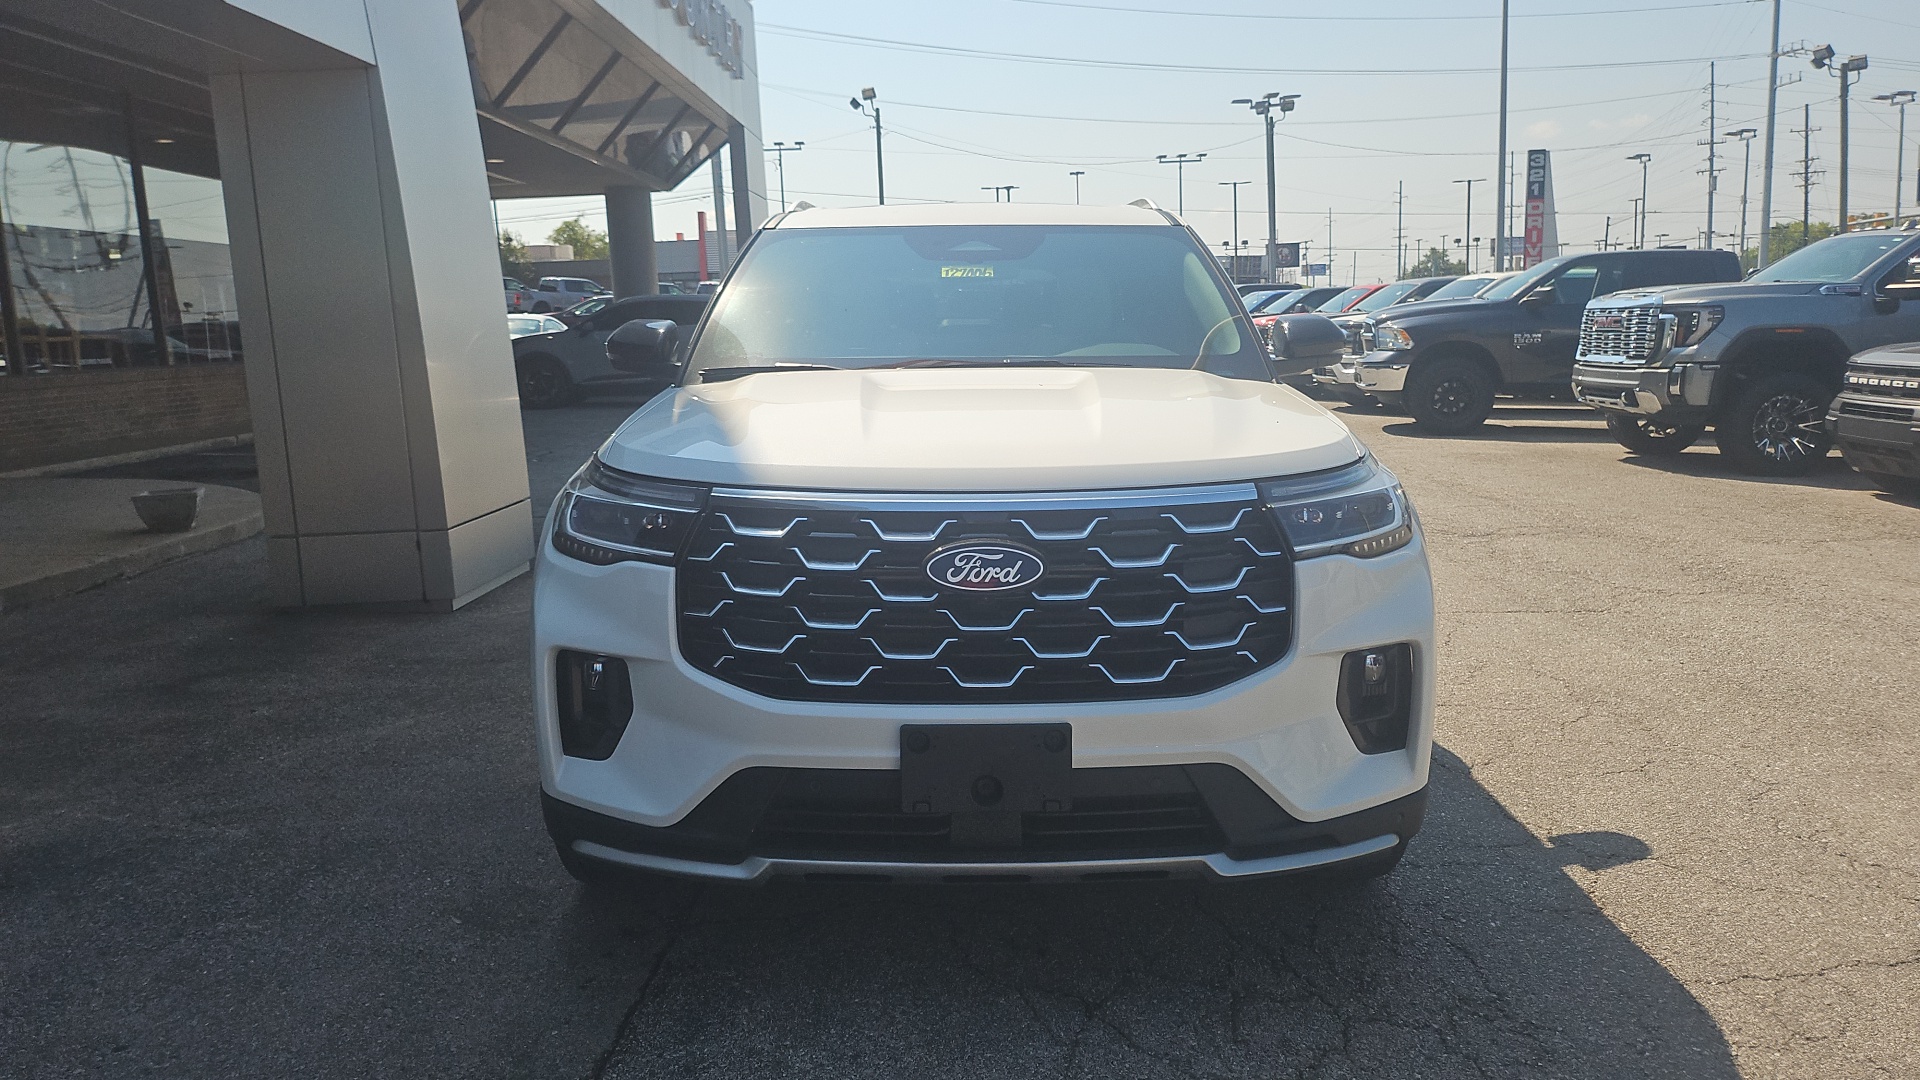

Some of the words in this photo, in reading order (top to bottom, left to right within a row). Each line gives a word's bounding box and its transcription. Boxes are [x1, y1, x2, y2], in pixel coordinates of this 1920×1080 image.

[1529, 153, 1545, 196] 321
[1526, 201, 1544, 268] DRIVE
[1591, 316, 1622, 328] GMC
[1849, 376, 1919, 389] BRONCO
[946, 552, 1023, 583] Ford
